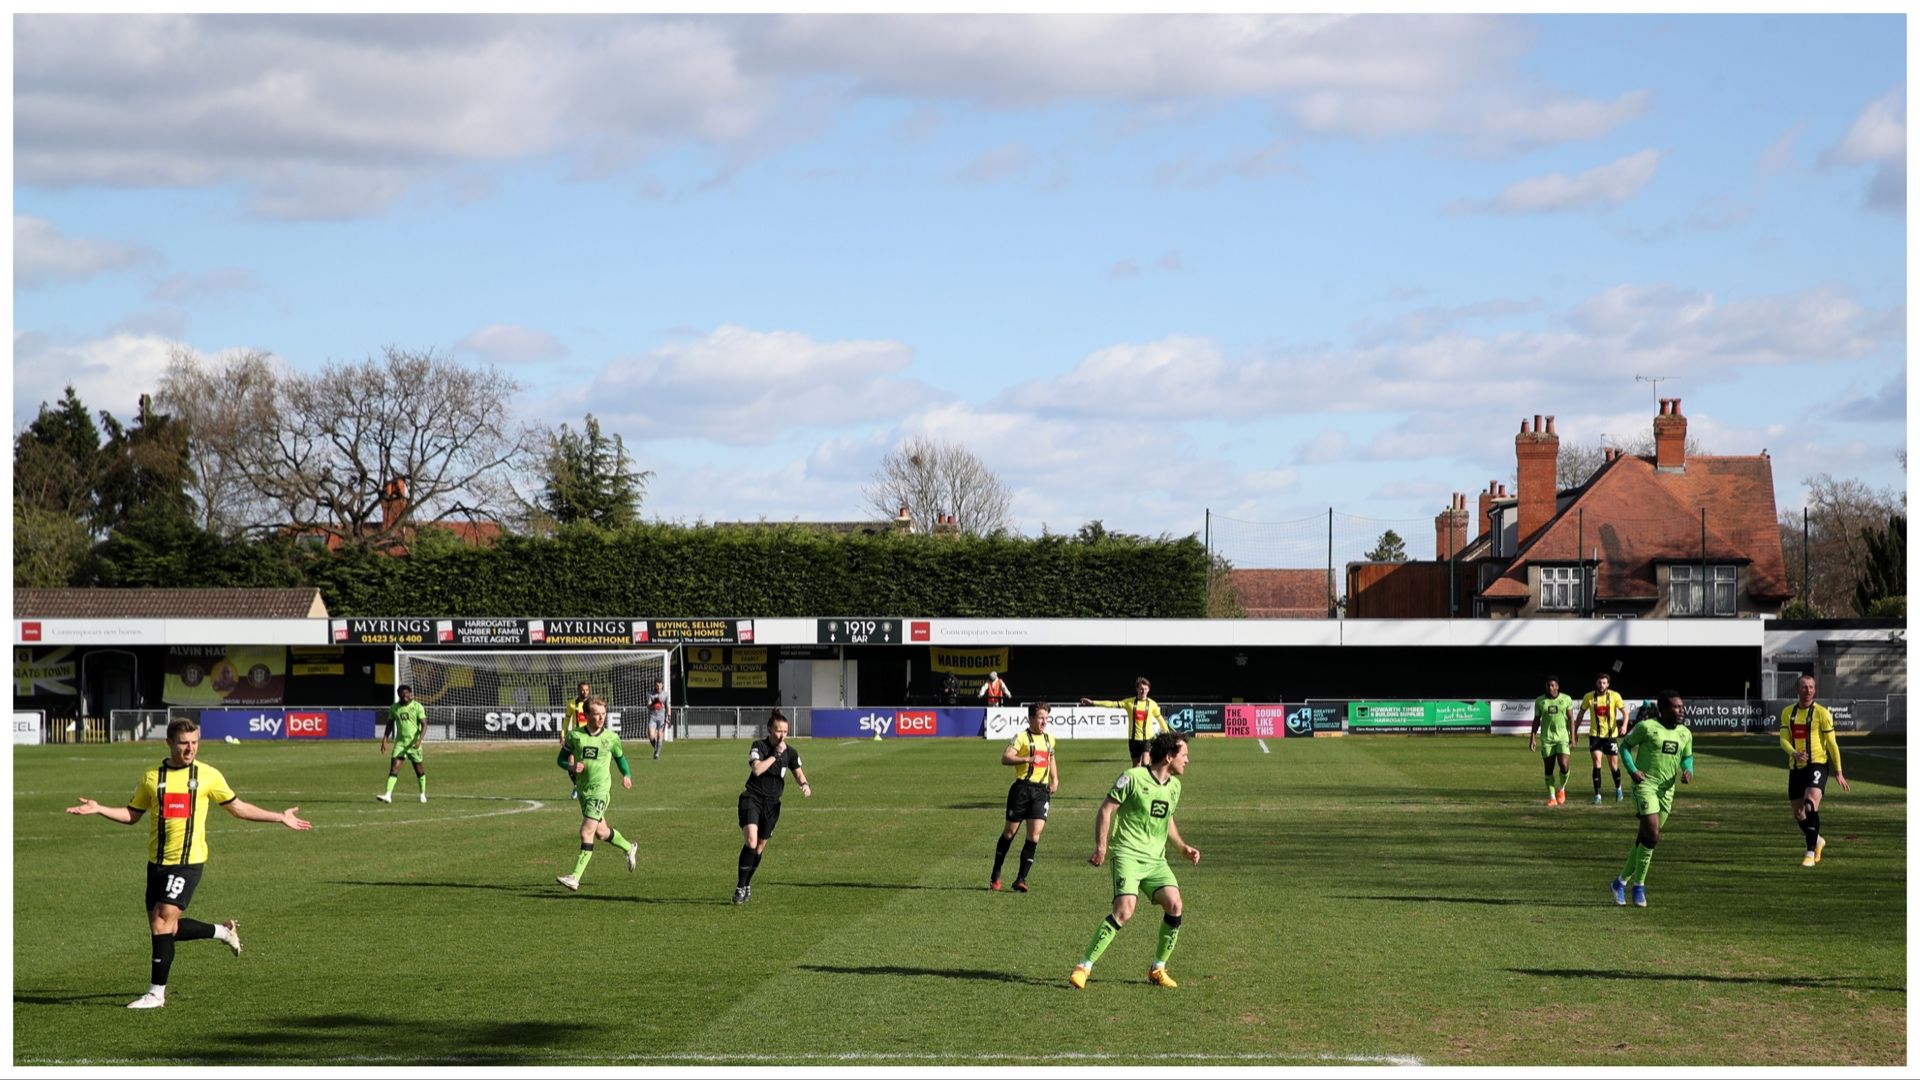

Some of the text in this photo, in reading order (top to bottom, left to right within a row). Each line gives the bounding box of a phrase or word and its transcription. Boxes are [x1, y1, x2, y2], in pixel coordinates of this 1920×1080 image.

[354, 620, 430, 632] MYRINGS
[464, 619, 517, 628] HARROGATE'S
[550, 621, 626, 633] MYRINGS
[655, 621, 728, 630] BUYING, SELLING,
[844, 621, 876, 635] 1919
[458, 627, 491, 636] NUMBER
[498, 627, 525, 636] FAMILY
[657, 629, 692, 637] LETTING
[694, 629, 724, 637] HOMES
[361, 635, 388, 643] 01423
[406, 635, 422, 643] 400
[462, 635, 520, 643] ESTATE AGENTS
[545, 636, 630, 644] #MYRINGSATHOME
[851, 635, 868, 643] BAR
[169, 646, 202, 657] ALVIN
[937, 653, 1001, 669] HARROGATE
[692, 663, 762, 672] HARROGATE TOWN
[1227, 709, 1242, 717] THE
[1255, 709, 1282, 717] SOUND
[1684, 705, 1762, 715] Want to strike
[859, 712, 933, 734] sky bet
[1009, 714, 1107, 726] HAROGATE
[1226, 718, 1248, 726] GOOD
[1255, 718, 1273, 726] LIKE
[1684, 715, 1776, 728] a winning smile?
[249, 714, 323, 736] sky bet
[1227, 727, 1250, 735] TIMES
[1255, 727, 1274, 735] THIS
[1813, 770, 1821, 784] 9
[165, 874, 186, 898] 18
